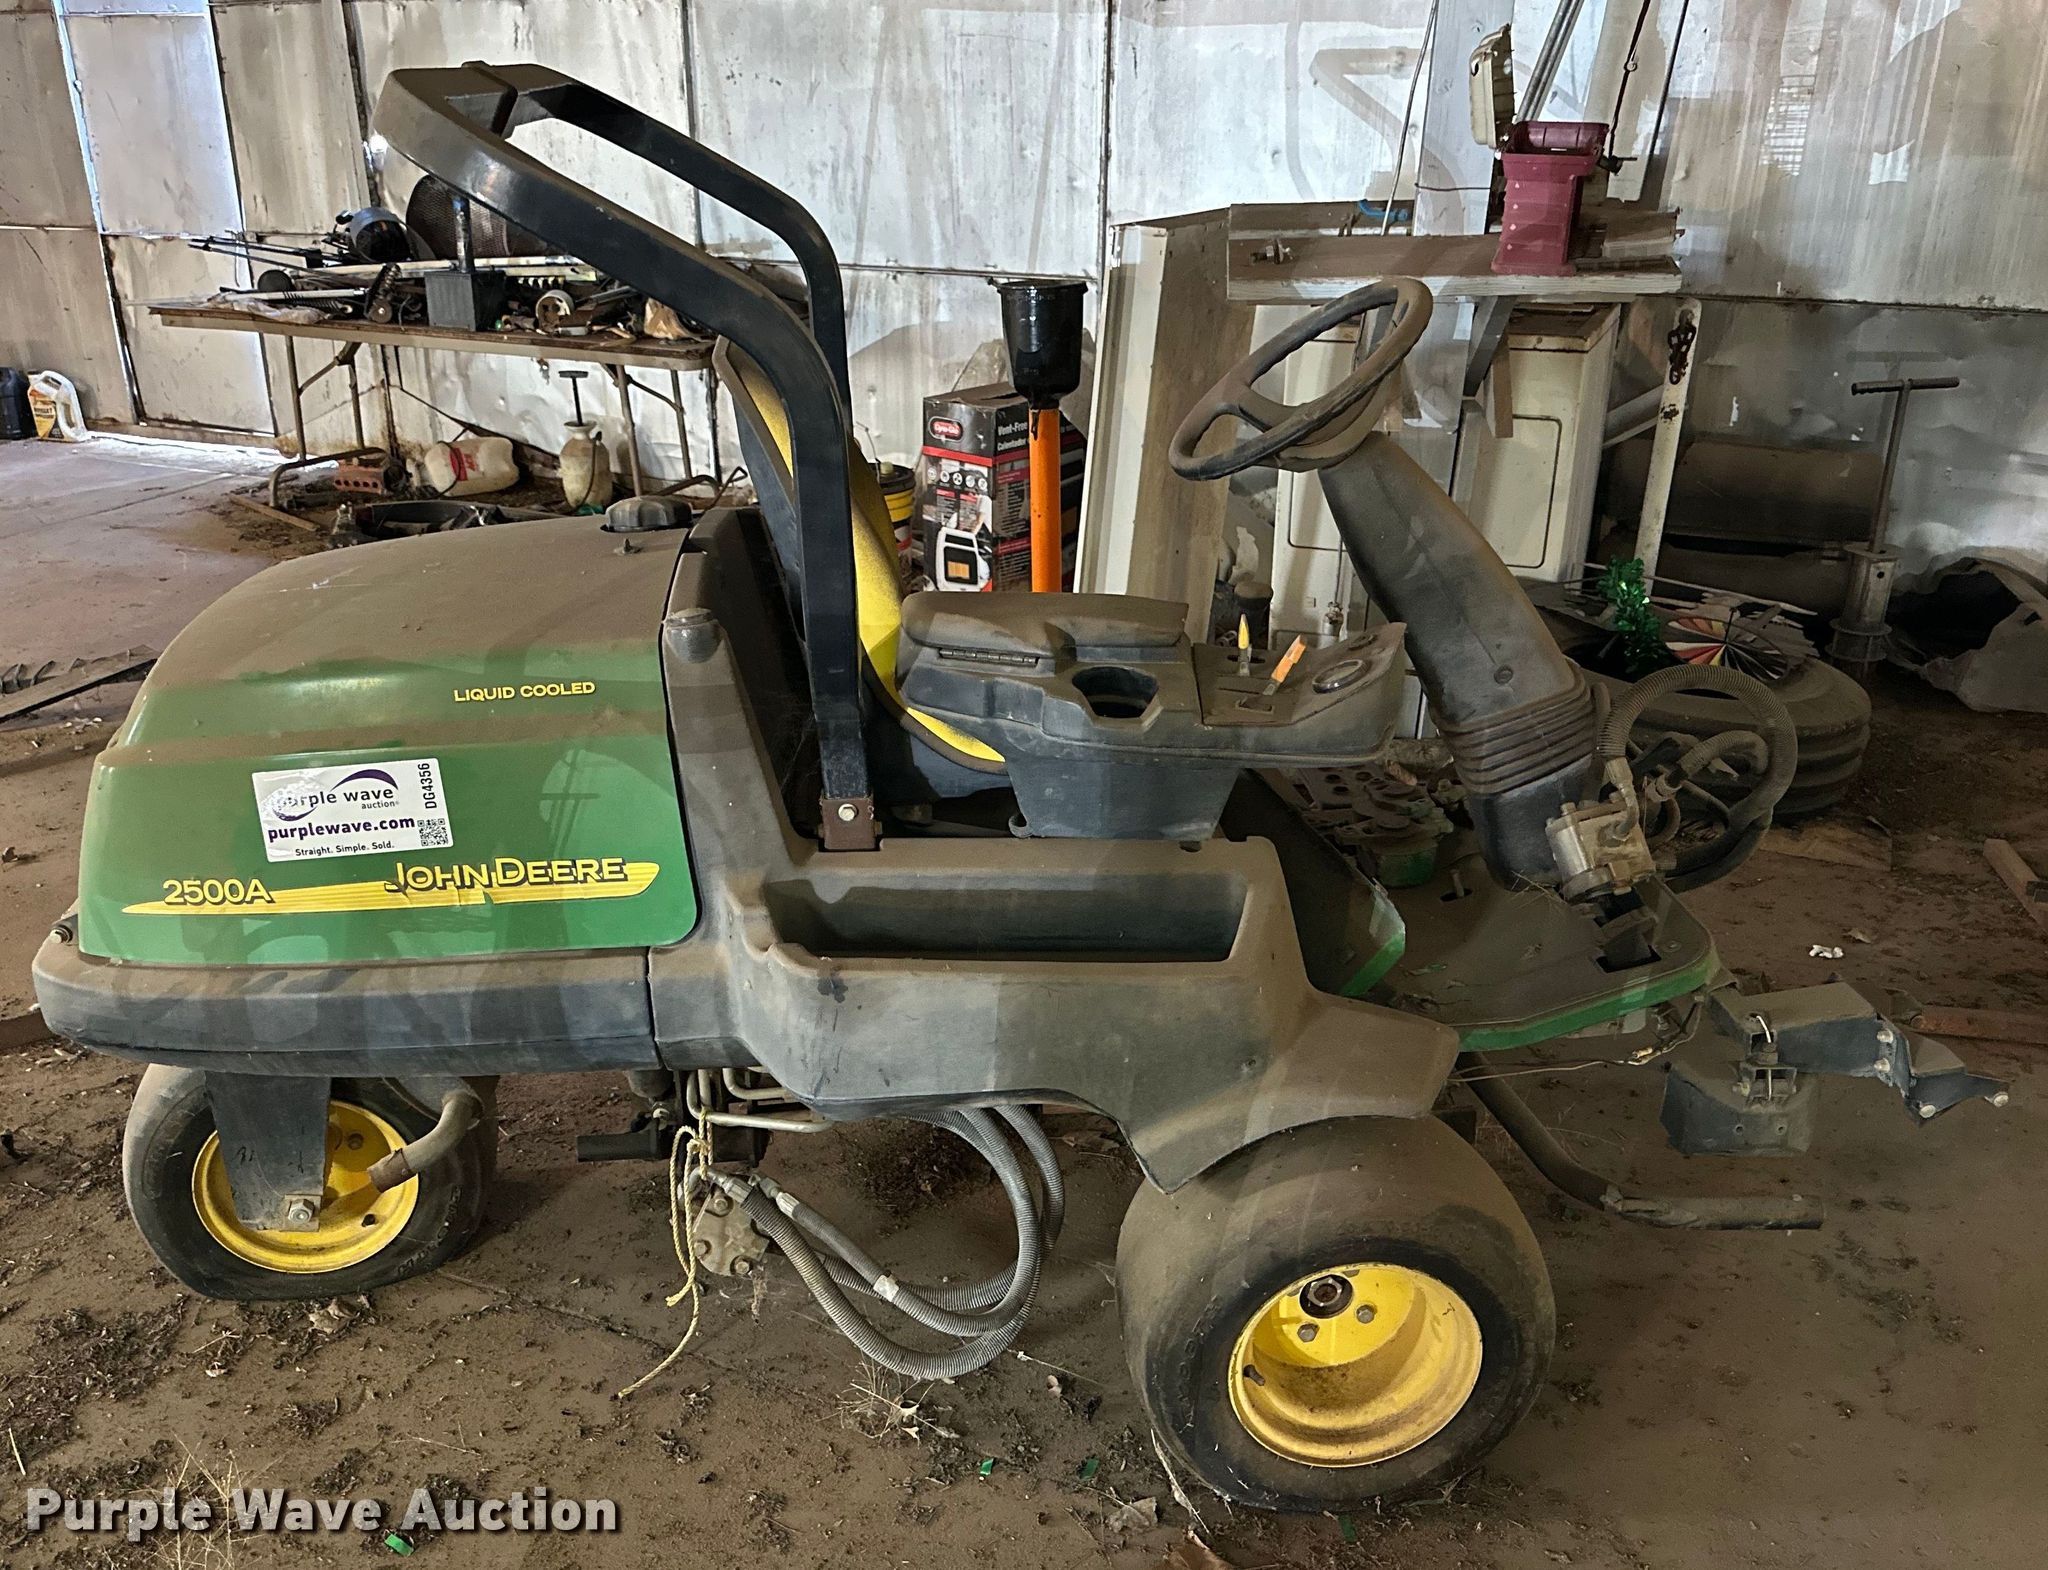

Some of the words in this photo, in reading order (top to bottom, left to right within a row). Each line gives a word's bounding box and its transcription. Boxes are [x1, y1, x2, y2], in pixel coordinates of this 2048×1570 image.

[453, 686, 516, 702] LIQUID
[519, 681, 596, 698] COOLED
[417, 762, 438, 809] DG4356
[278, 790, 338, 811] rple
[343, 786, 394, 802] wave
[267, 817, 415, 843] purplewave.com
[295, 847, 334, 857] Straight.
[335, 844, 370, 854] Simple.
[371, 840, 395, 850] Sold.
[163, 879, 276, 906] 2500A
